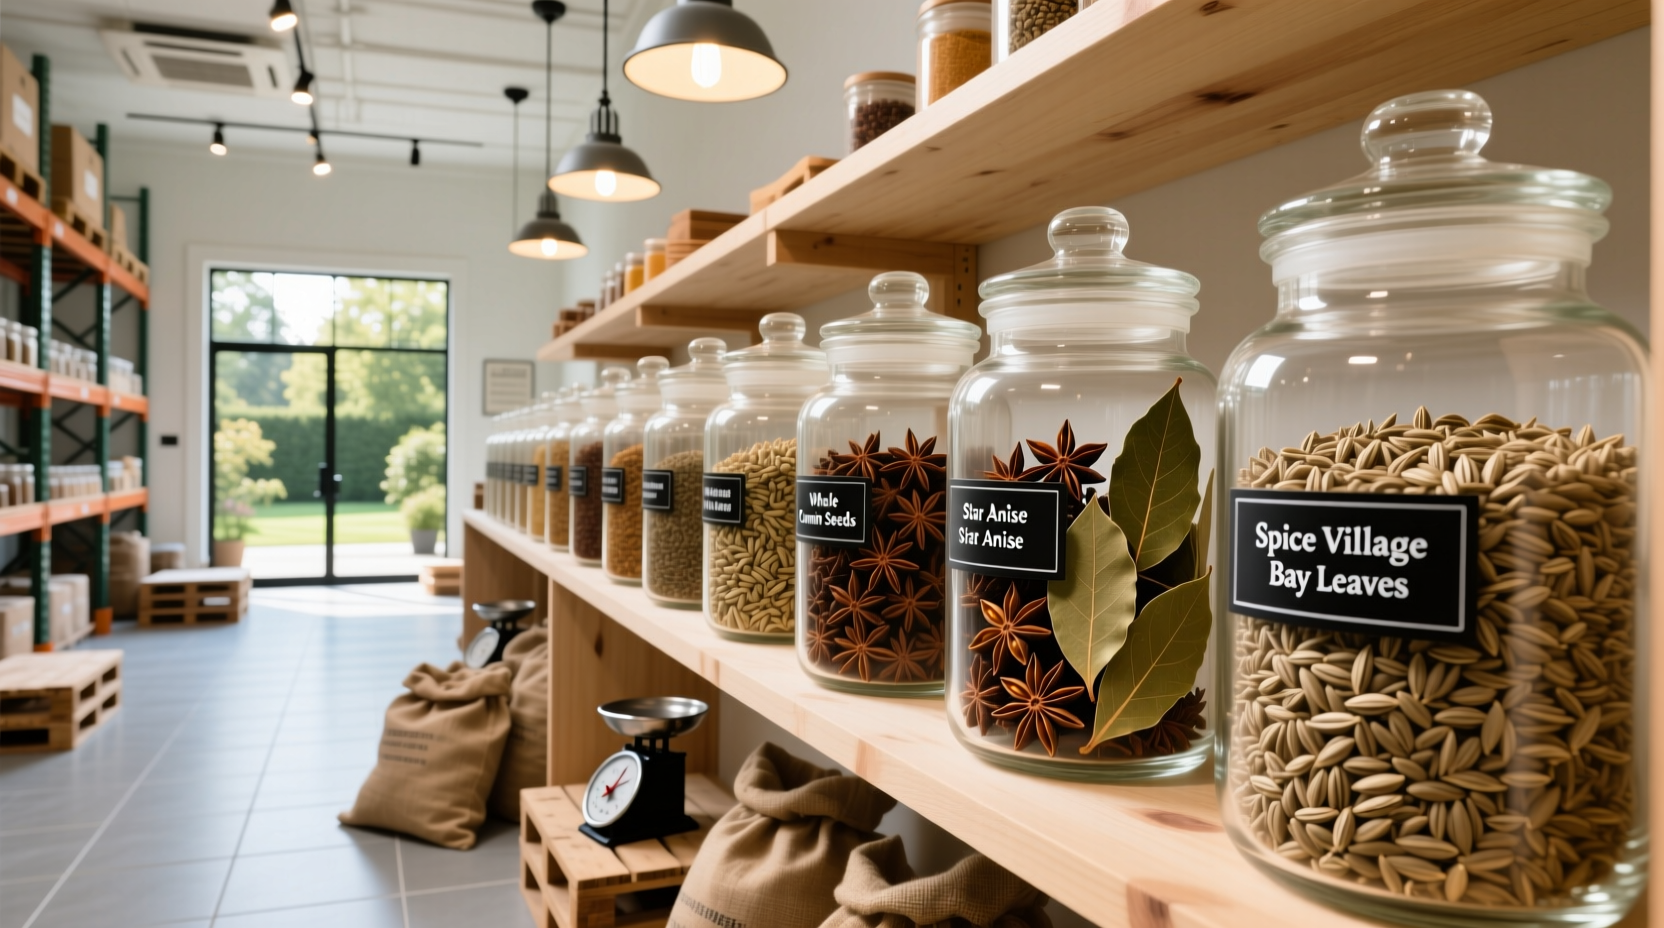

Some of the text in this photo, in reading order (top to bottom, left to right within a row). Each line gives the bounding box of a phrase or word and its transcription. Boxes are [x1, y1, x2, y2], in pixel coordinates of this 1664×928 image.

[824, 511, 857, 527] Seeds
[986, 503, 1028, 524] Anise
[981, 529, 1024, 550] Anise
[1255, 521, 1429, 567] Spice Village
[1268, 560, 1409, 599] Bay Leaves
